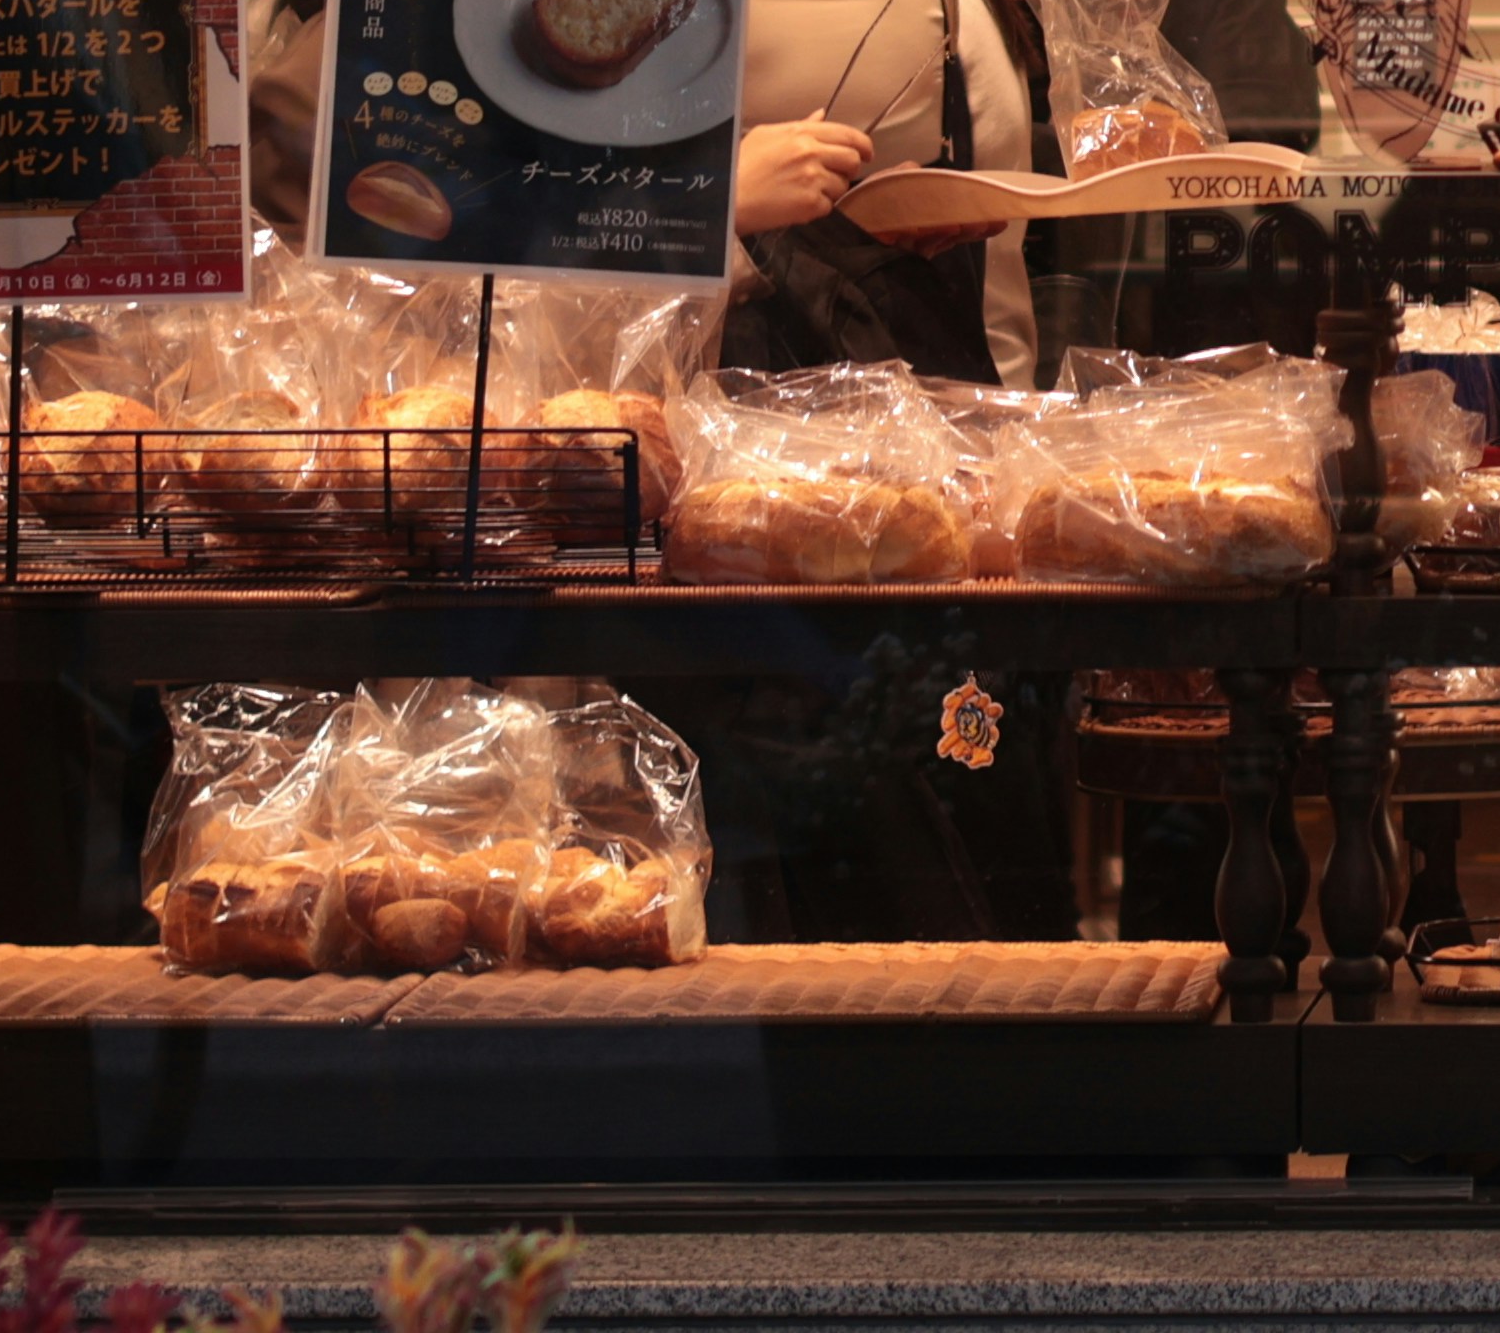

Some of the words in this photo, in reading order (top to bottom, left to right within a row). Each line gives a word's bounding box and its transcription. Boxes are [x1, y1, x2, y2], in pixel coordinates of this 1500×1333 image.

[1358, 33, 1485, 119] Madame
[521, 159, 715, 191] チーズバタール
[1167, 175, 1328, 199] YOKOHAMA
